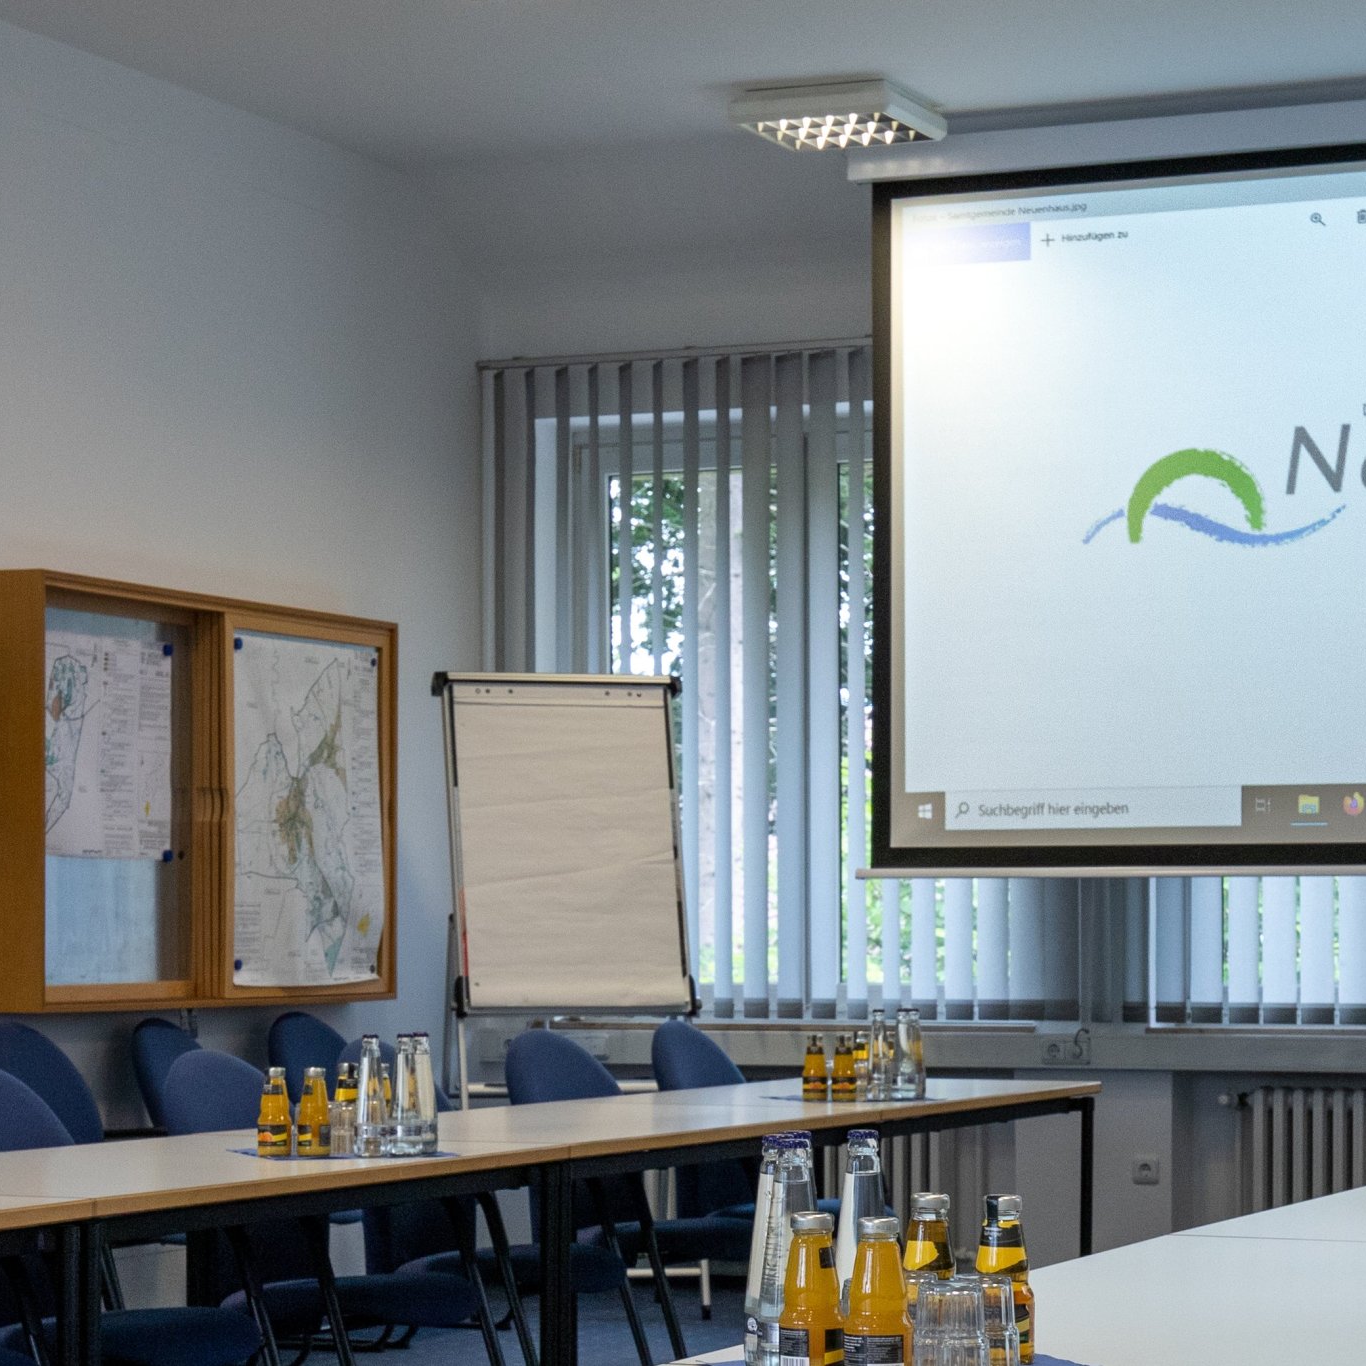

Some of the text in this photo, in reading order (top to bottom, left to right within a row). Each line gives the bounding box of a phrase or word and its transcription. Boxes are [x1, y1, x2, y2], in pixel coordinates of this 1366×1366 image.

[1061, 230, 1129, 244] Hinzufügen zu
[978, 802, 1129, 819] Suchbegriff hier eingeben
